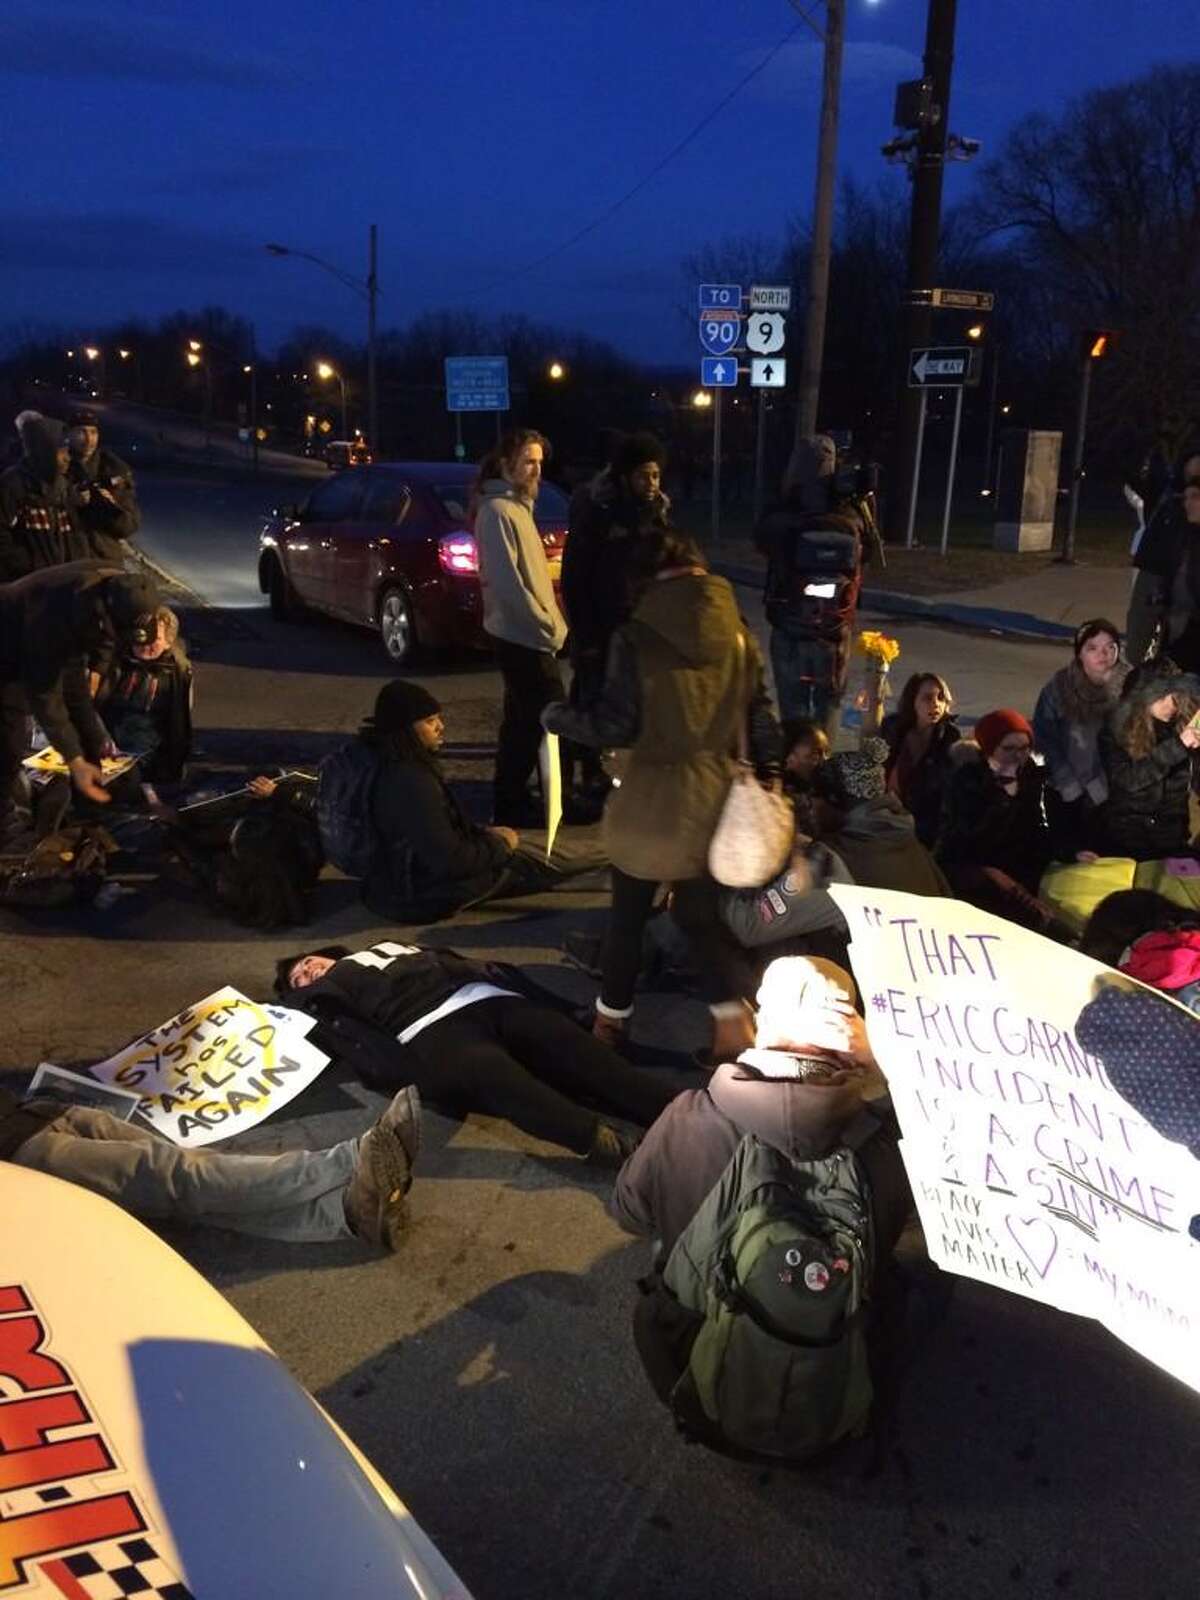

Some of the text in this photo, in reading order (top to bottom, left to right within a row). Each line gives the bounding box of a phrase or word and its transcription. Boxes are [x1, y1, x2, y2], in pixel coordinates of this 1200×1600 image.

[710, 290, 730, 303] TO
[752, 291, 790, 304] NORTH
[706, 322, 734, 343] 90
[759, 322, 773, 344] 9
[115, 999, 252, 1088] SYSTEM
[136, 1009, 195, 1048] THE
[136, 1024, 276, 1119] FAILED
[174, 1035, 229, 1077] has
[177, 1054, 301, 1139] AGAIN
[916, 1050, 1139, 1152] INCIDENT
[985, 1153, 1008, 1184] A
[989, 1113, 1015, 1146] A
[1034, 1123, 1175, 1225] CRIME
